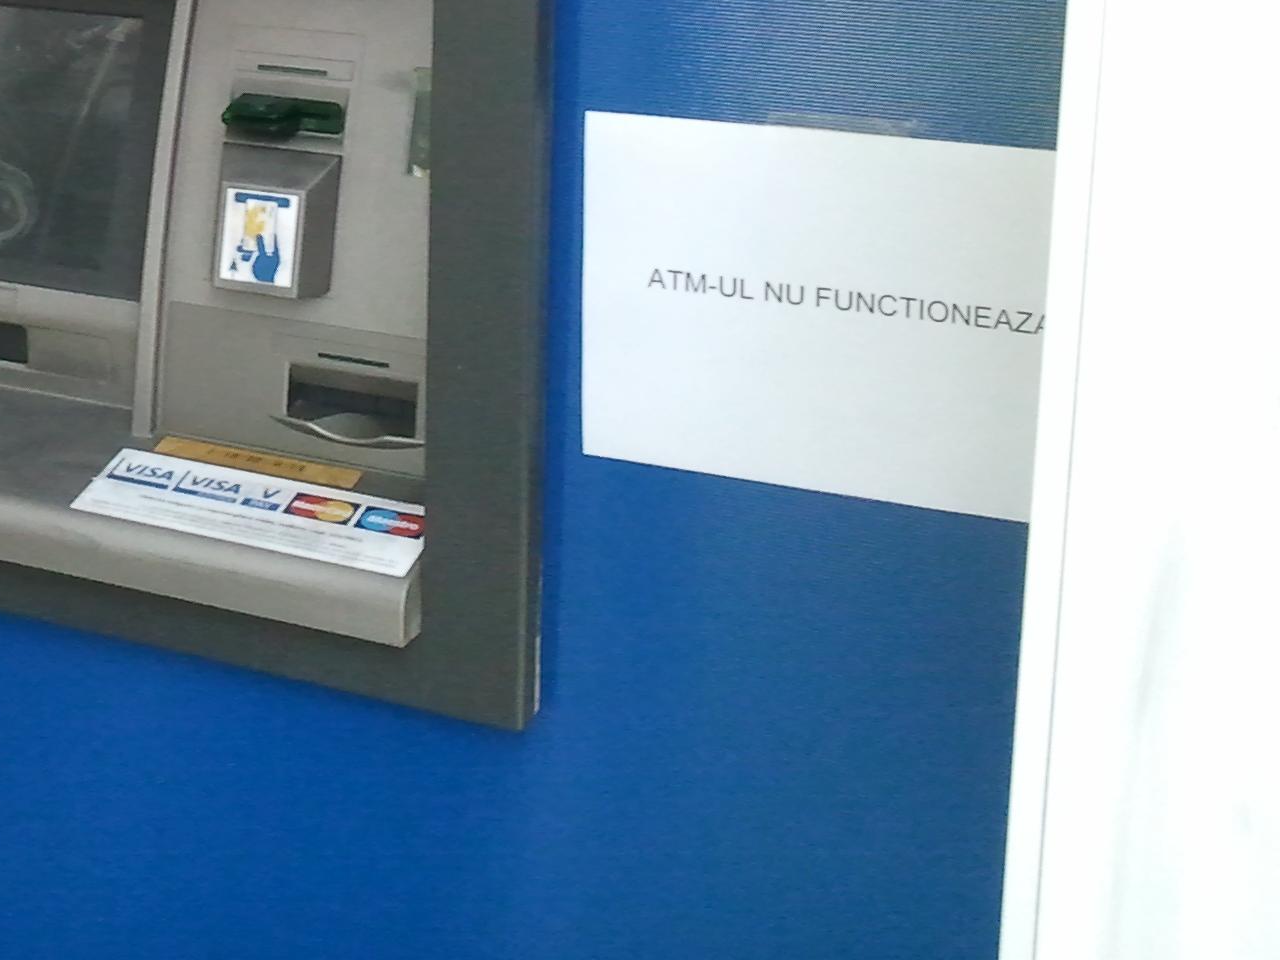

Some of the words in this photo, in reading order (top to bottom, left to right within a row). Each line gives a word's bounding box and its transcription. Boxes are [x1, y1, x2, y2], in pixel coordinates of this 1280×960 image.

[647, 267, 755, 301] ATM-UL
[763, 280, 806, 306] NU
[125, 462, 174, 481] VISA
[190, 475, 242, 494] VISA
